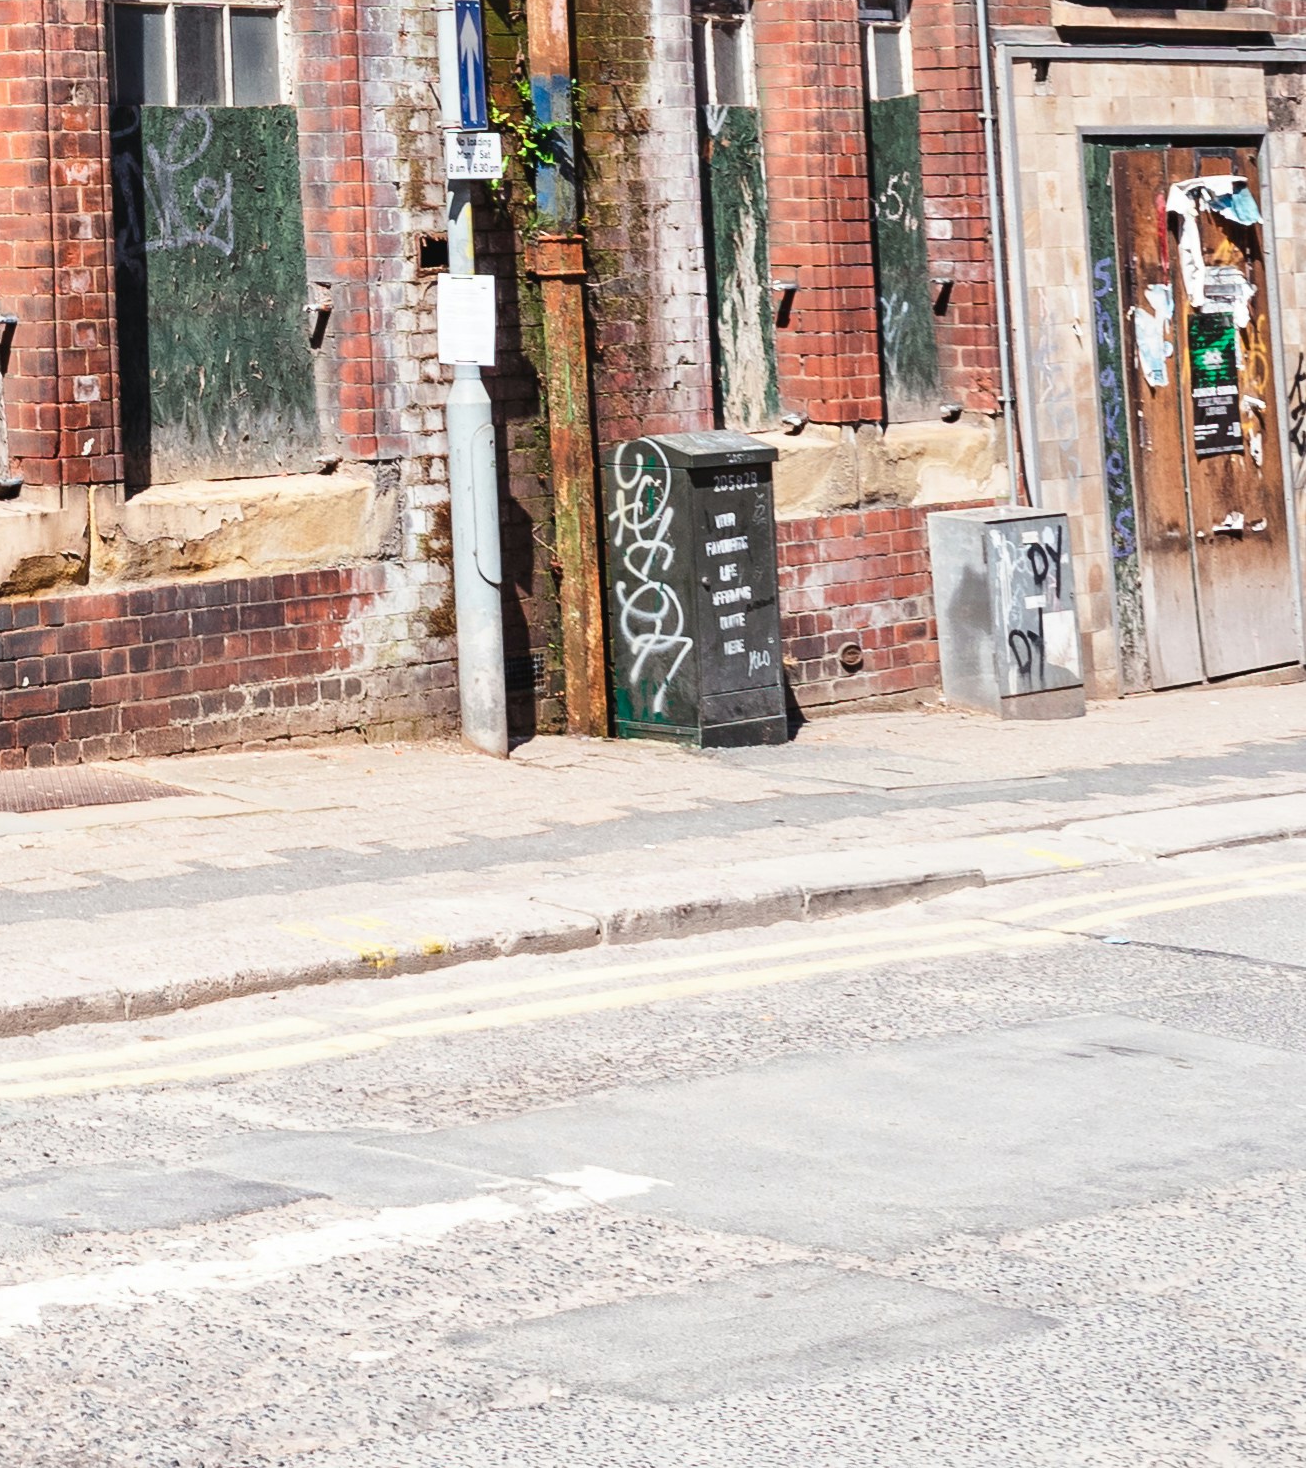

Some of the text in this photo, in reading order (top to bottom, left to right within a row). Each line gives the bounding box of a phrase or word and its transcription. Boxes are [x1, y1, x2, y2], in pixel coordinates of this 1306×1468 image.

[467, 137, 492, 148] loading
[479, 149, 491, 159] Sat
[714, 512, 737, 530] YOUR
